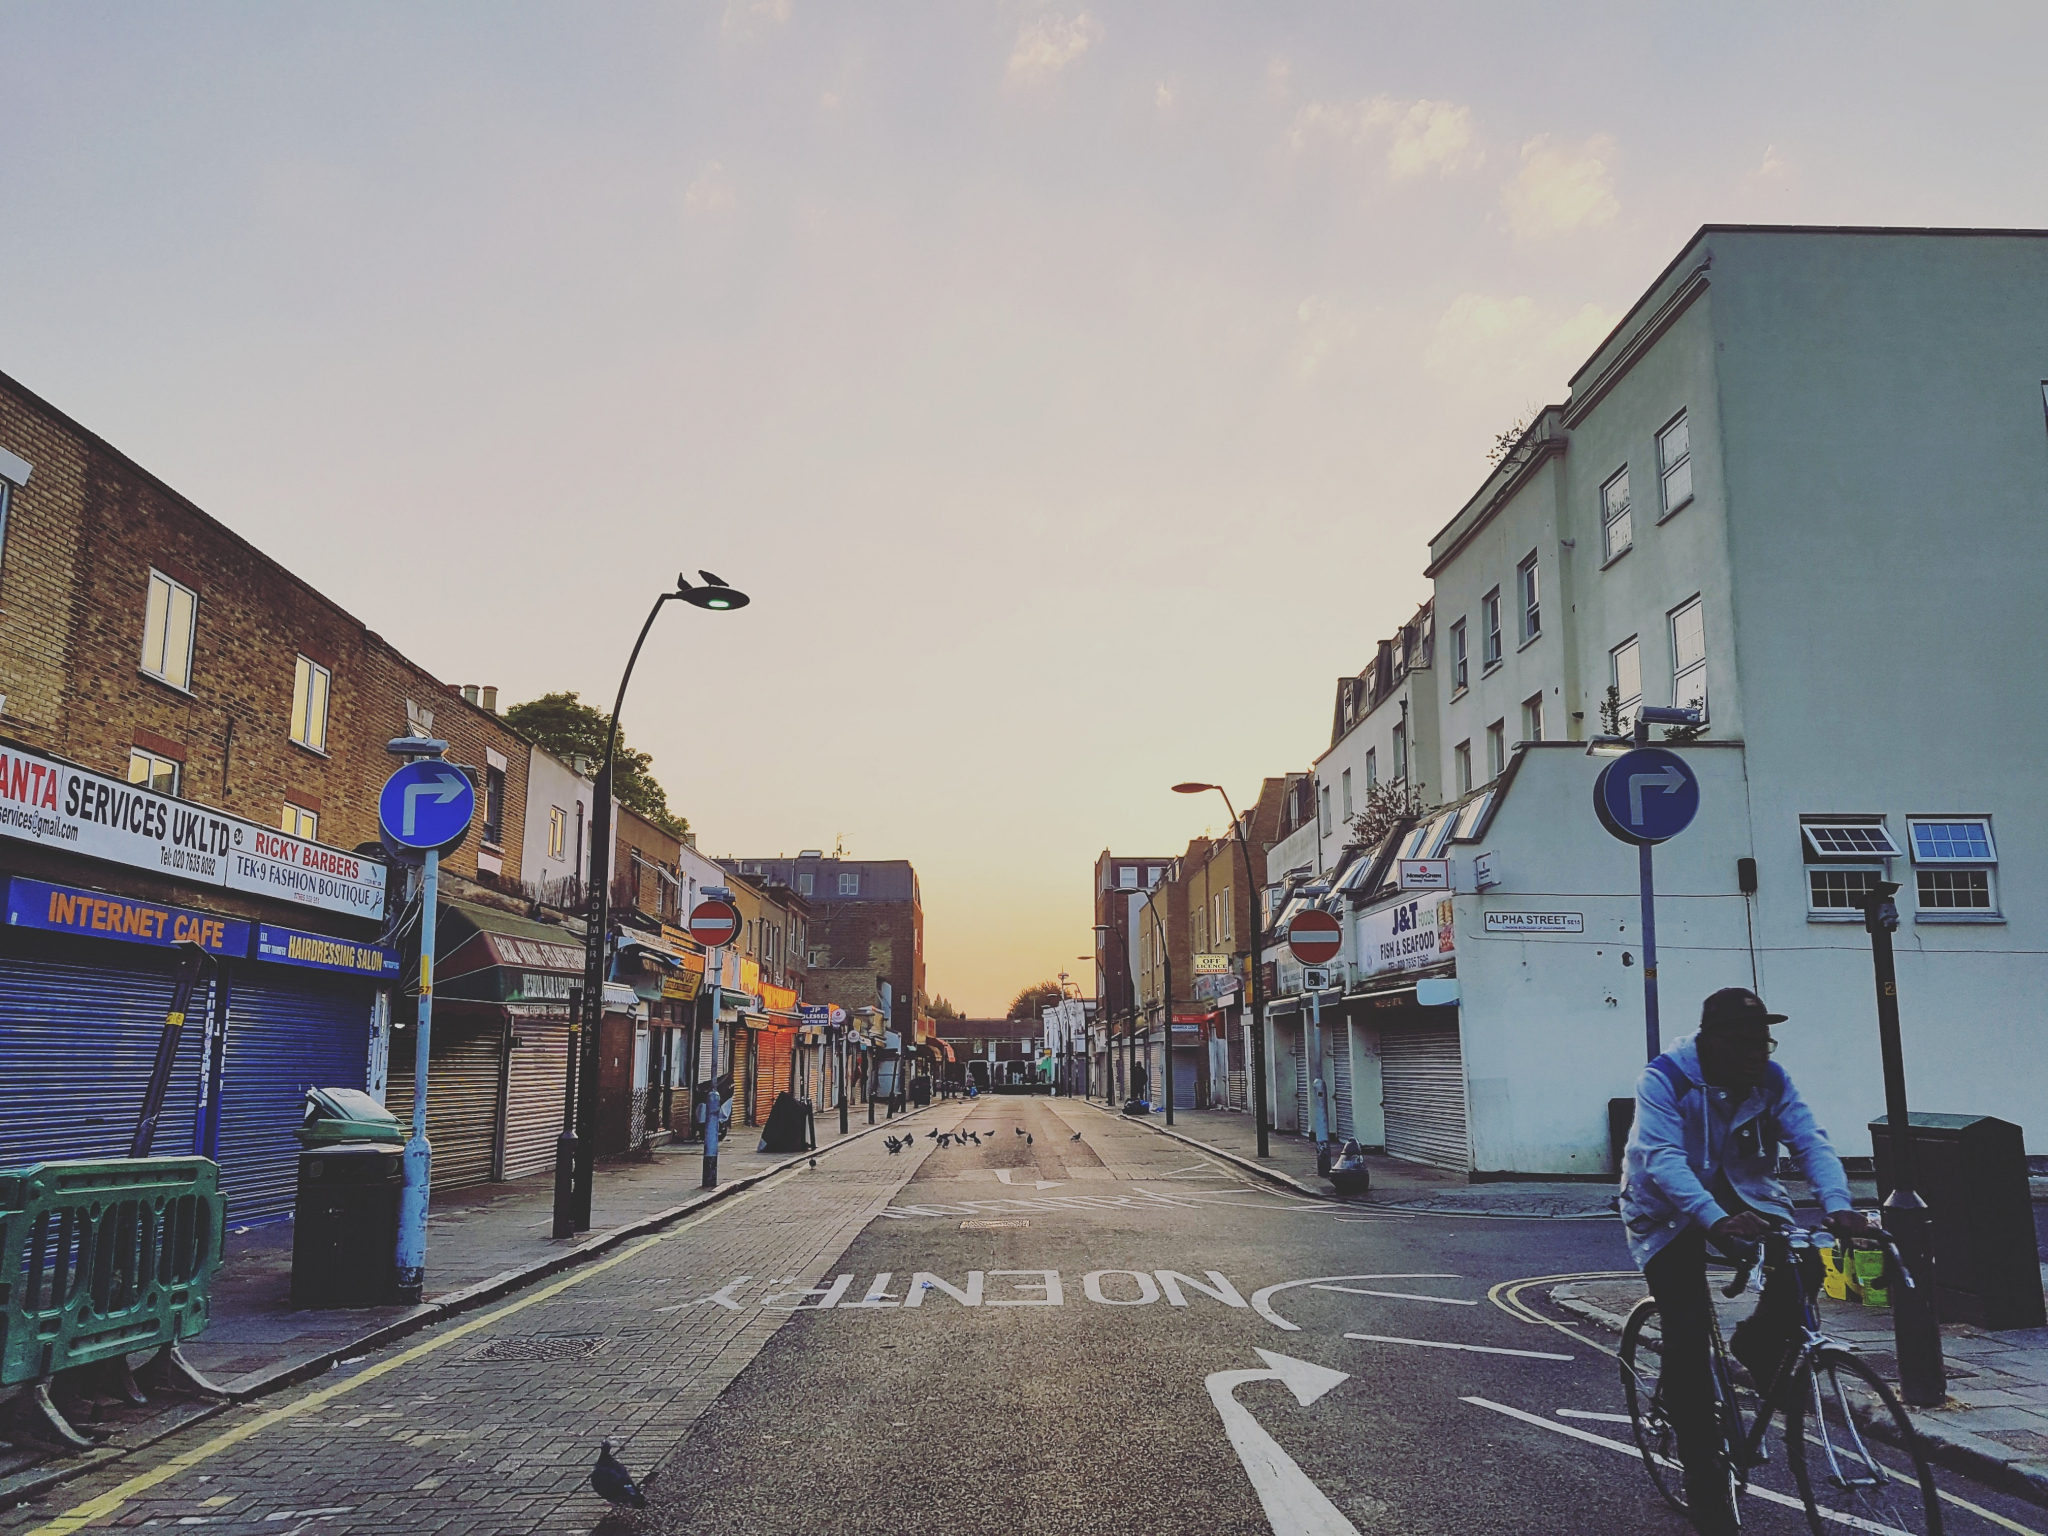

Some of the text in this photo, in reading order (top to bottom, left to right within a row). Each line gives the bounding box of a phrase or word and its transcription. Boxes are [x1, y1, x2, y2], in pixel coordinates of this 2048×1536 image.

[65, 775, 168, 841] SERVICES
[173, 849, 185, 869] 020
[255, 832, 359, 879] RICKY BARBERS
[269, 865, 317, 893] FASHION
[318, 878, 370, 907] BOUTIQUE
[48, 892, 225, 948] INTERNET CAFE
[589, 878, 600, 970] CHOUMERT
[1392, 901, 1418, 936] J&T
[1488, 914, 1524, 924] ALPHA
[1526, 915, 1567, 925] STREET
[287, 935, 355, 967] HAIRDRESSING
[356, 948, 383, 972] SALON
[1380, 931, 1435, 960] FISH & SEAFOOD
[585, 986, 596, 1057] MARKET
[1083, 1269, 1251, 1309] NO
